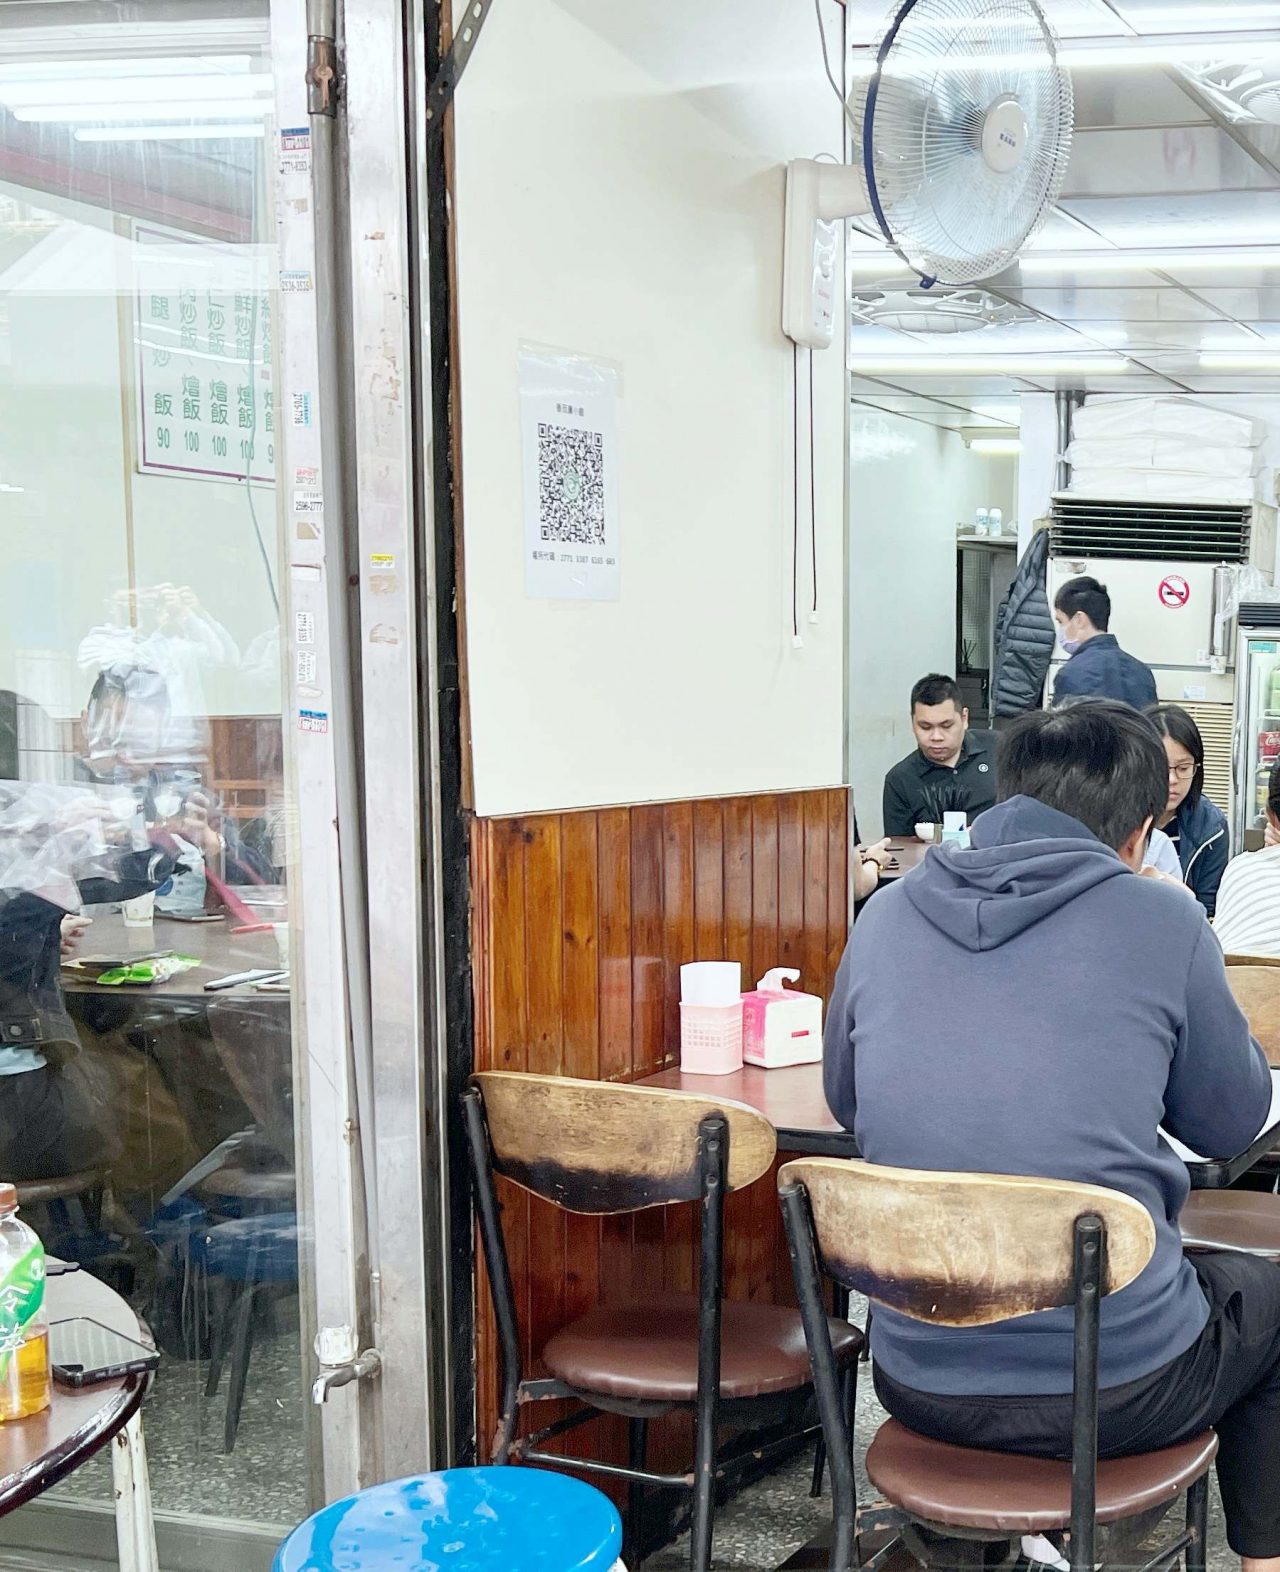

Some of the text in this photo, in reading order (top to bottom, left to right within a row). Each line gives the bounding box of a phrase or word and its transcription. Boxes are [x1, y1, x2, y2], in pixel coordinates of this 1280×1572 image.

[156, 426, 171, 449] 90
[184, 431, 200, 453] 100
[211, 435, 227, 457] 100
